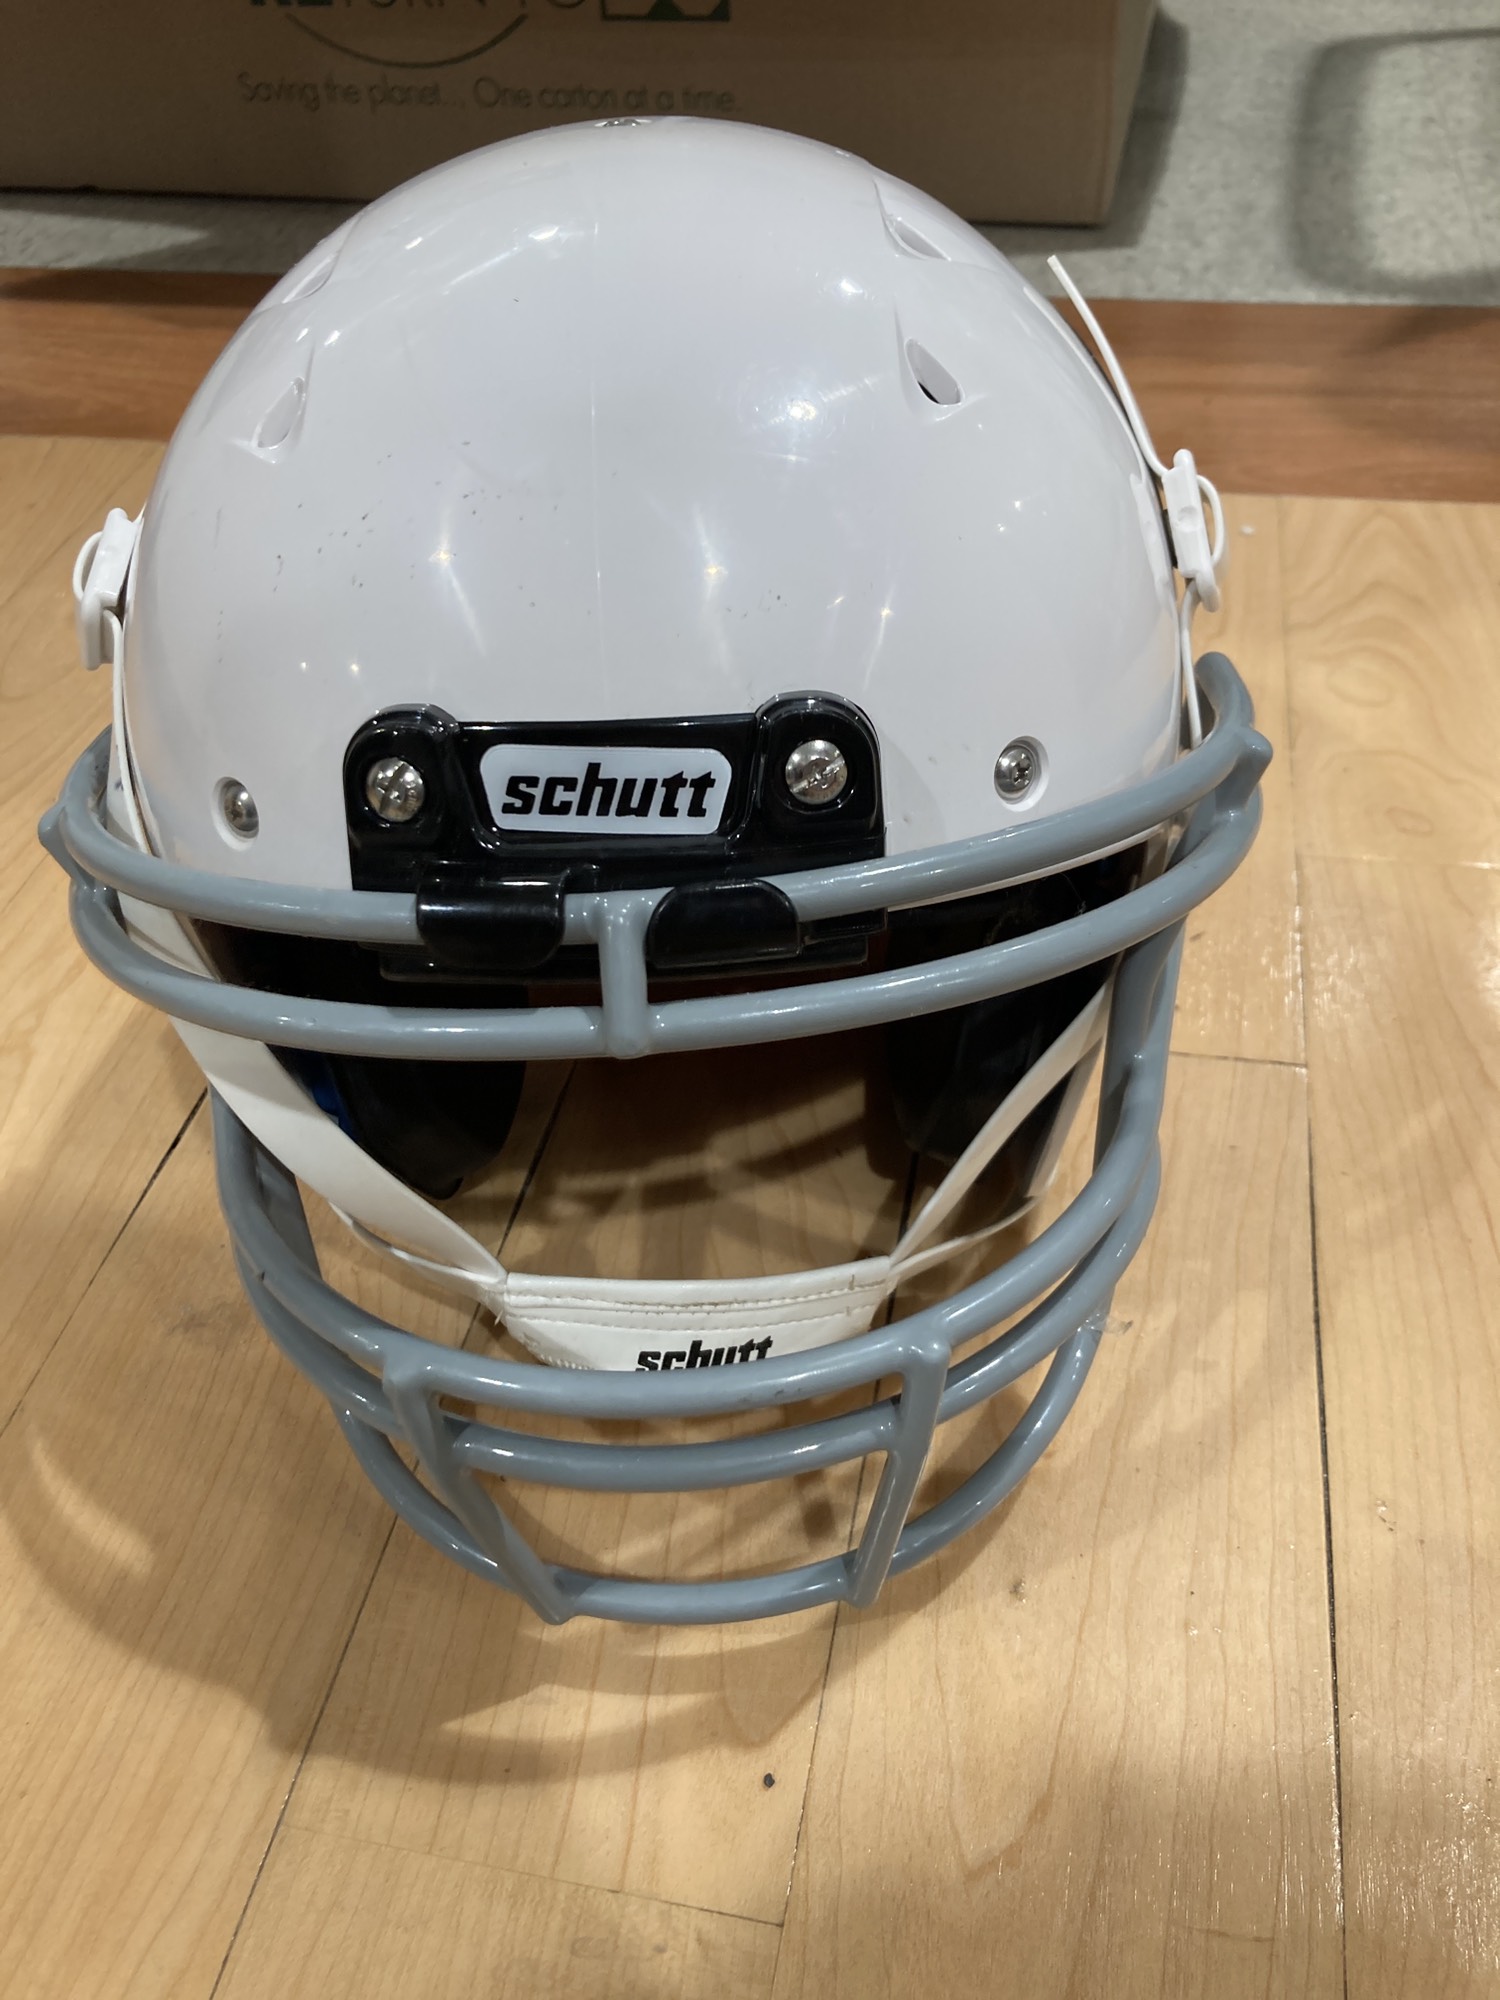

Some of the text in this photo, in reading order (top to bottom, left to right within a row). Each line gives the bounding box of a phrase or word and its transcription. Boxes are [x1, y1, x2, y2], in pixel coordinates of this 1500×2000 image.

[237, 71, 320, 112] Saving
[324, 72, 360, 104] the
[474, 76, 531, 108] One
[538, 82, 617, 110] carton
[623, 84, 649, 110] at
[656, 90, 675, 111] a
[501, 762, 716, 817] schutt
[635, 1335, 773, 1371] schutt
